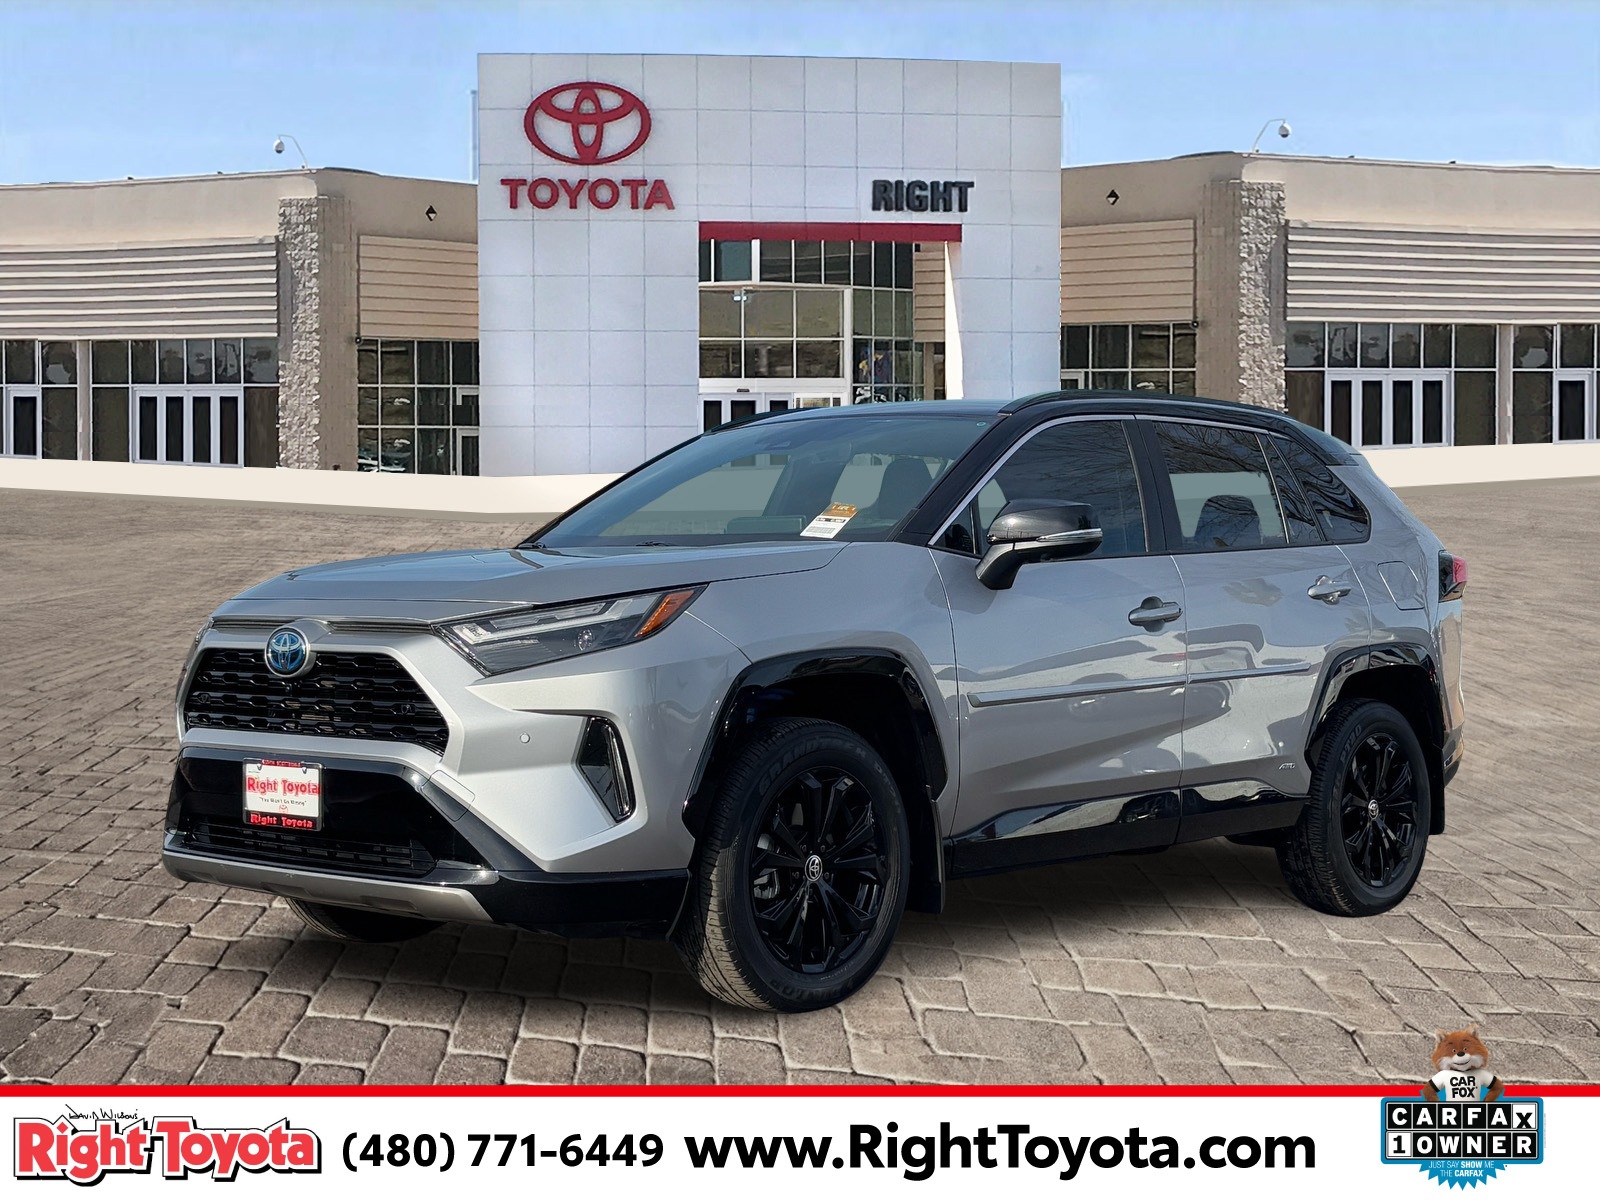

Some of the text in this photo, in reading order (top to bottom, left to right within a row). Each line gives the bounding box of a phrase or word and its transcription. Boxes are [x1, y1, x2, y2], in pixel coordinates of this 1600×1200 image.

[500, 179, 675, 210] TOYOTA
[871, 179, 975, 213] RIGHT
[247, 776, 320, 797] Right Toyota
[250, 813, 313, 828] Right Toyota
